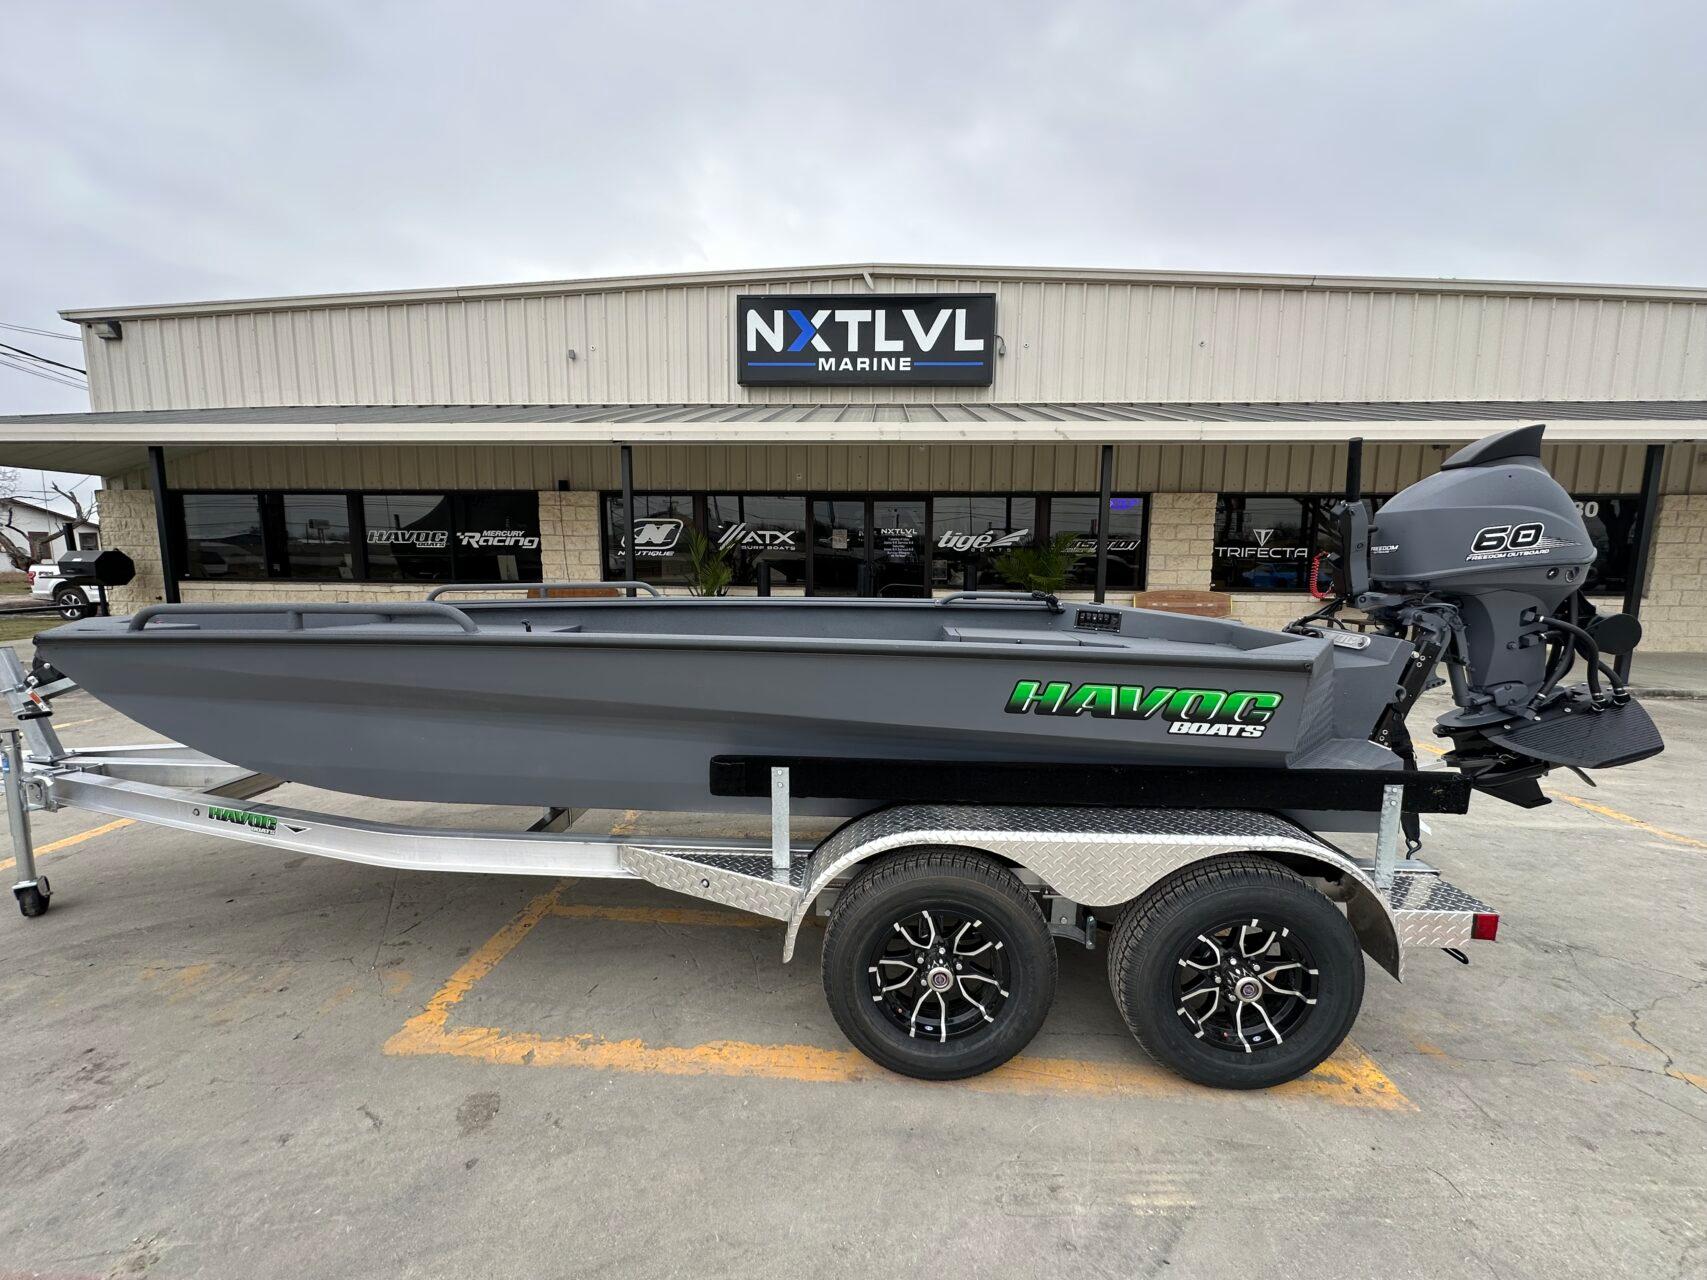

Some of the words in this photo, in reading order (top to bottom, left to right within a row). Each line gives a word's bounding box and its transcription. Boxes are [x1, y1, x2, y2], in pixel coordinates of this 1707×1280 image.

[746, 309, 985, 352] NXTLVL
[818, 357, 912, 371] MARINE
[367, 530, 449, 544] HAVOC
[462, 532, 540, 549] Racing
[742, 530, 796, 545] ATX
[1471, 522, 1545, 553] 60
[1214, 547, 1308, 558] TRIFECTA
[1466, 551, 1507, 561] FREEDOM
[1507, 548, 1550, 558] OUTBOARD
[1003, 679, 1285, 725] HAVOC
[1167, 721, 1267, 739] BOATS
[208, 806, 278, 830] HAVOC
